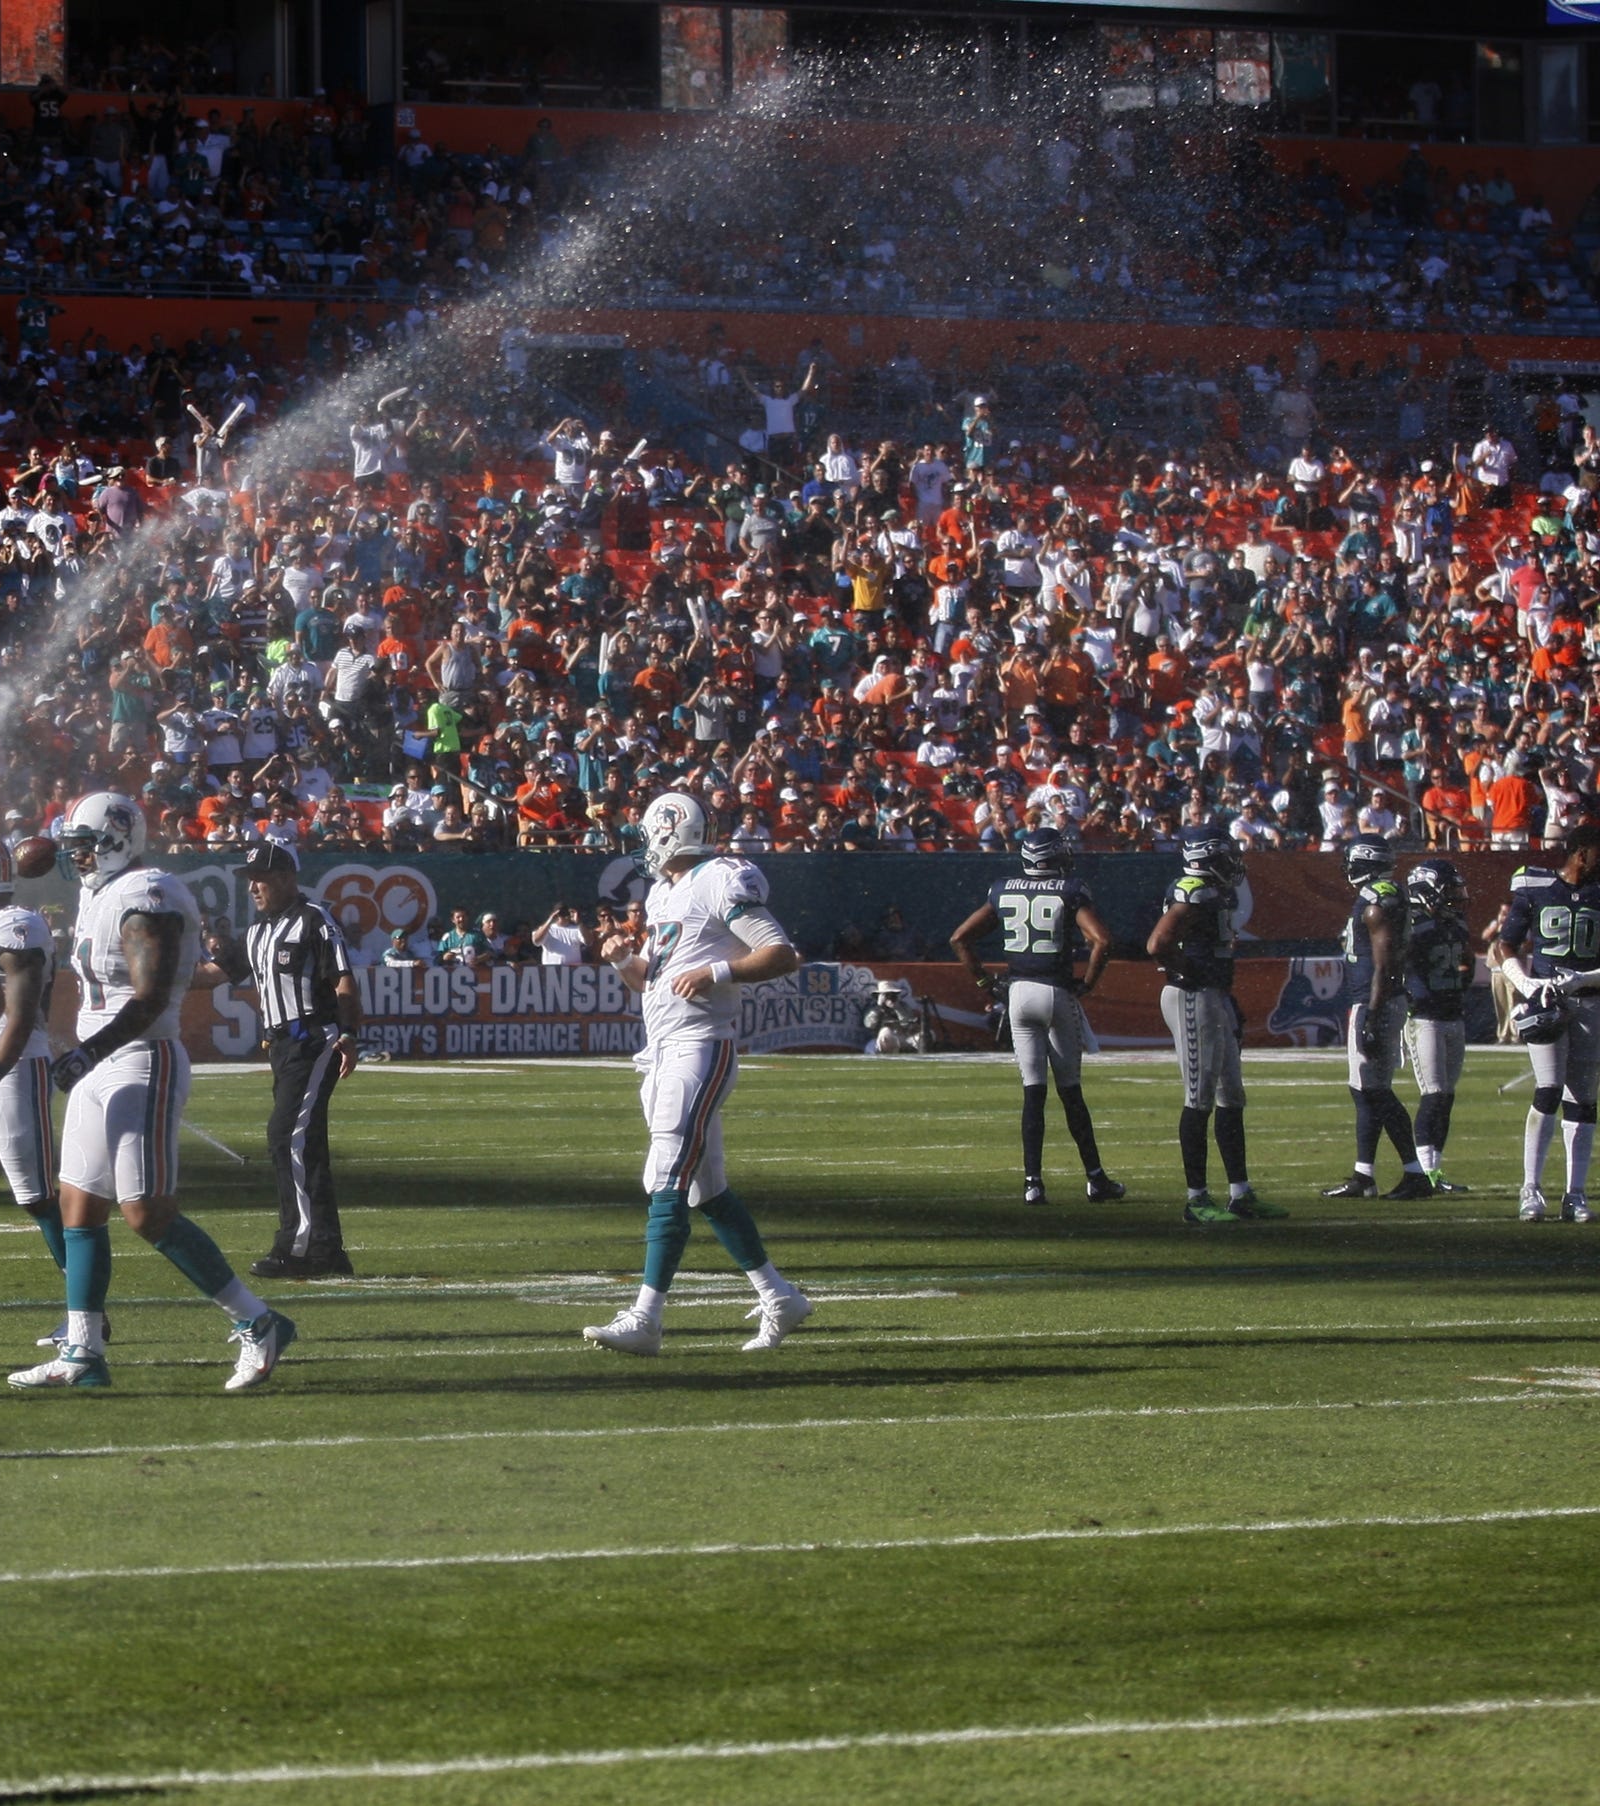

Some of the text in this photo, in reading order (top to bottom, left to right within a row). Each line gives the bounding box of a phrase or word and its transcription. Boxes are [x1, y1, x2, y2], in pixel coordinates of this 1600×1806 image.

[39, 101, 59, 118] 55
[828, 636, 842, 657] 7
[252, 716, 276, 734] 29
[1004, 878, 1066, 891] BROWNER
[998, 894, 1065, 953] 39
[1314, 963, 1332, 978] M
[355, 965, 477, 1016] ARLOS
[807, 971, 832, 993] 58
[446, 1023, 581, 1053] DIFFERENCE
[589, 1022, 646, 1052] MAK
